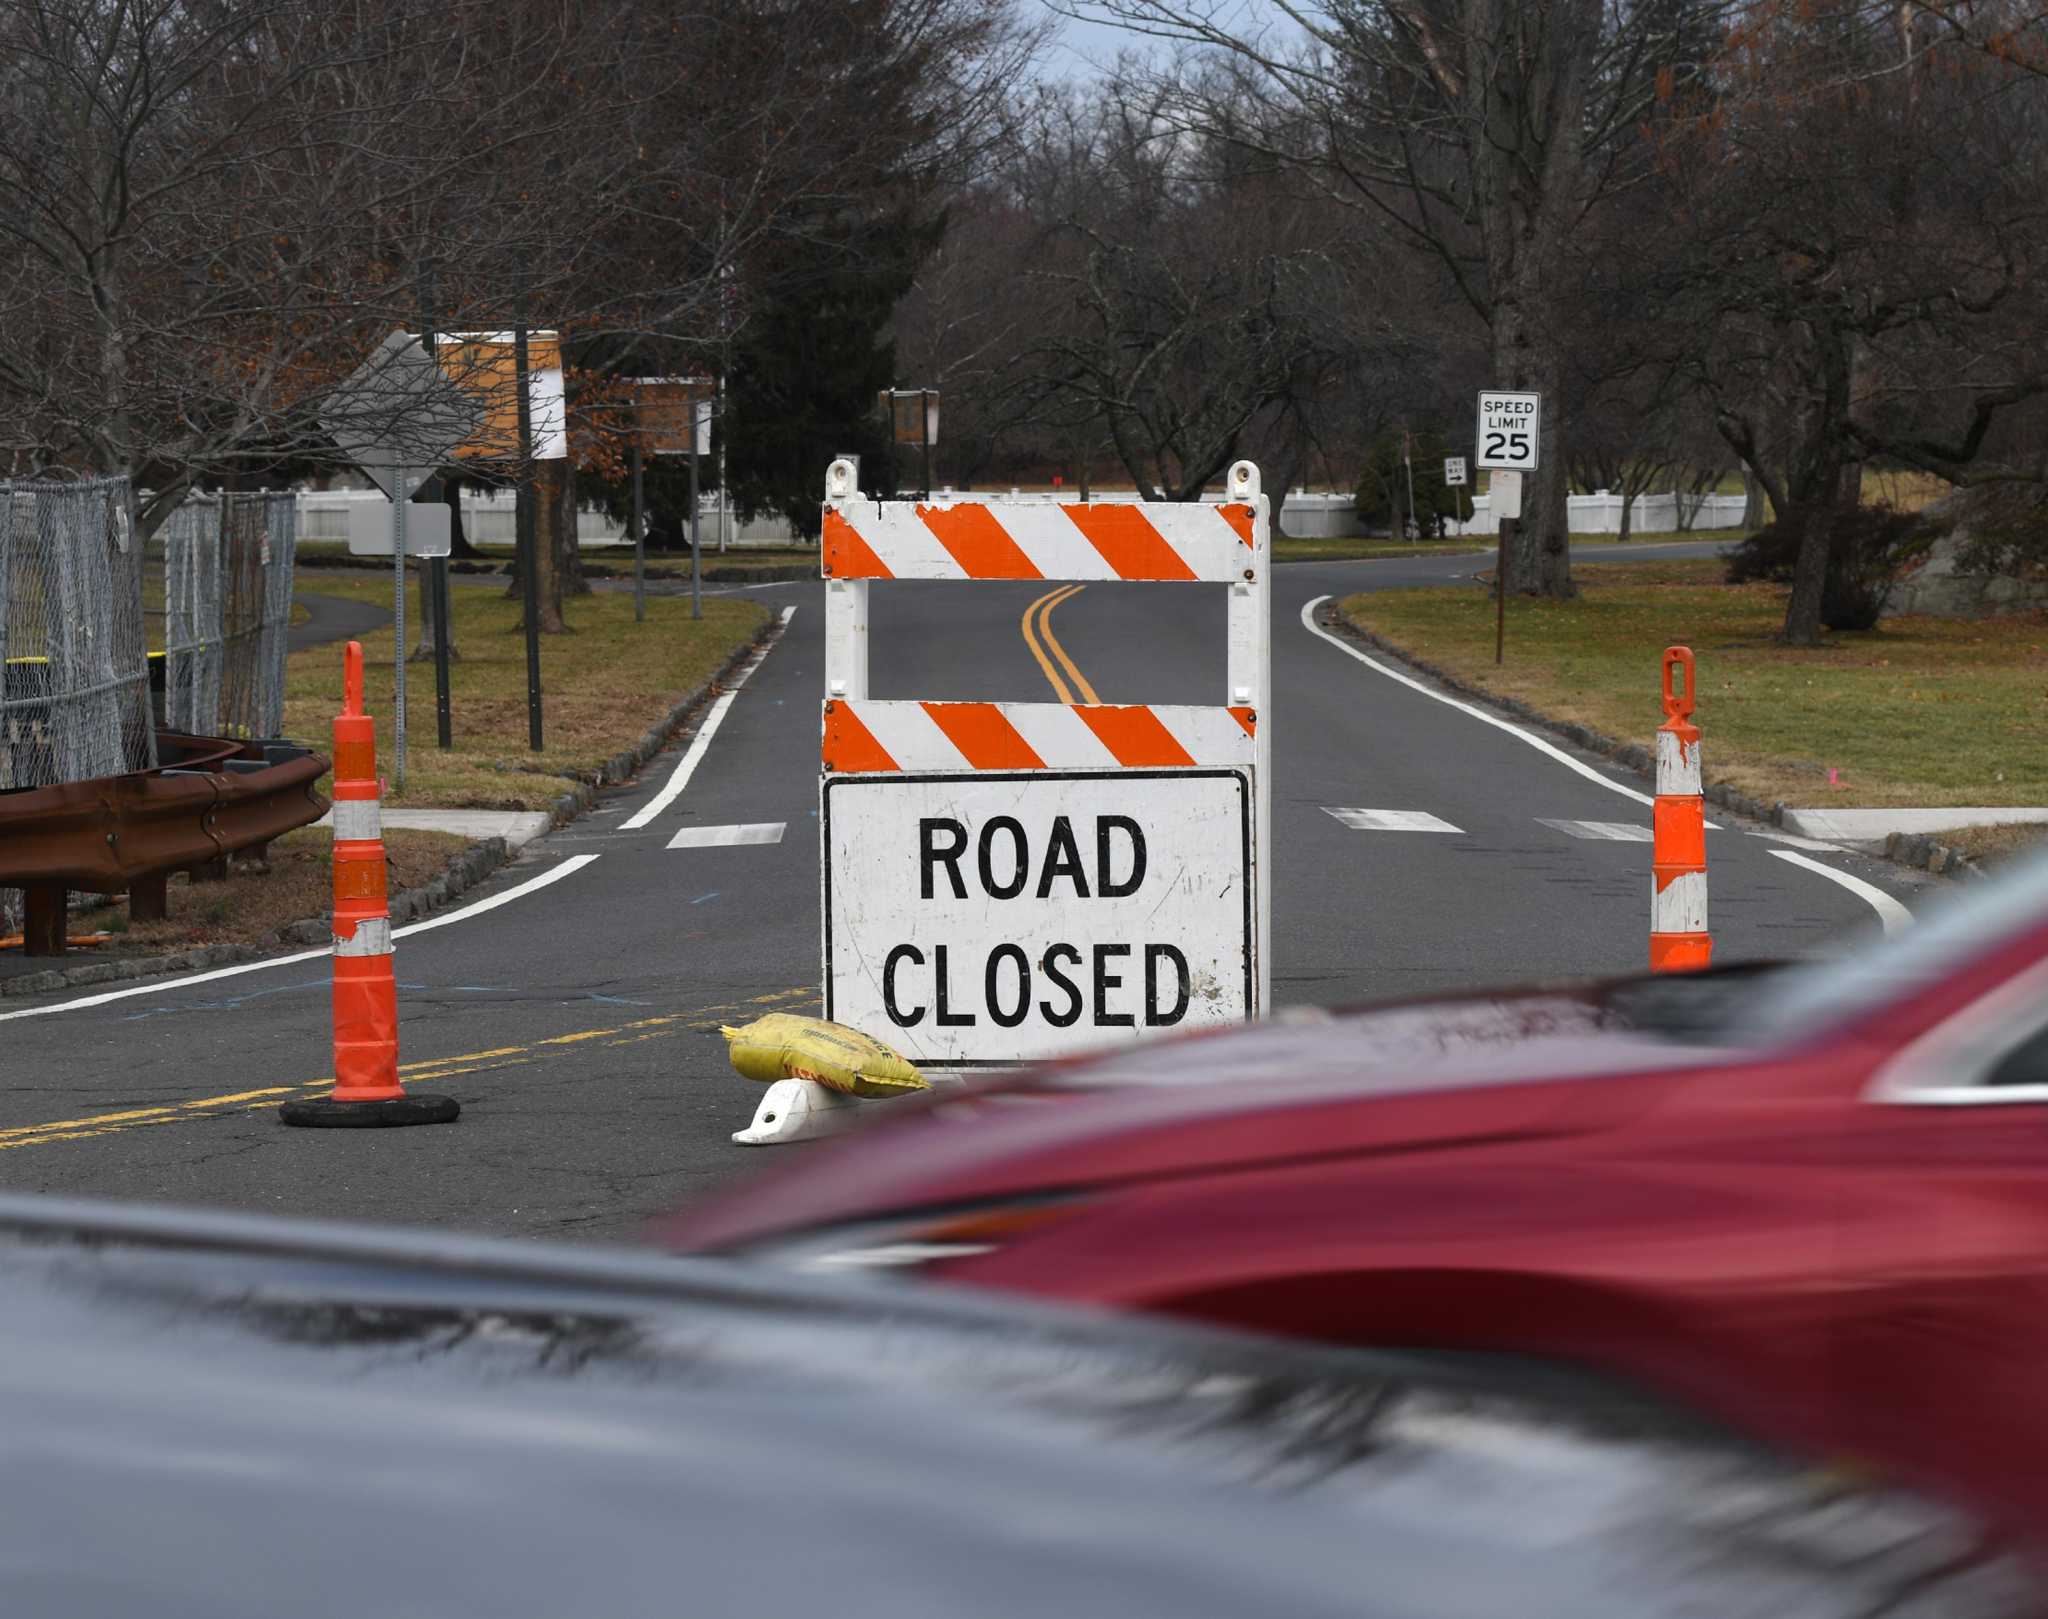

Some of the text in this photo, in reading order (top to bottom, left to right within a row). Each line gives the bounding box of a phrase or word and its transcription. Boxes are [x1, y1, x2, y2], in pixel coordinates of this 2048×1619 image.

[1484, 401, 1535, 414] SPEED
[1488, 417, 1528, 429] LIMIT
[1484, 432, 1530, 461] 25
[919, 815, 1147, 900] ROAD
[883, 943, 1191, 1028] CLOSED
